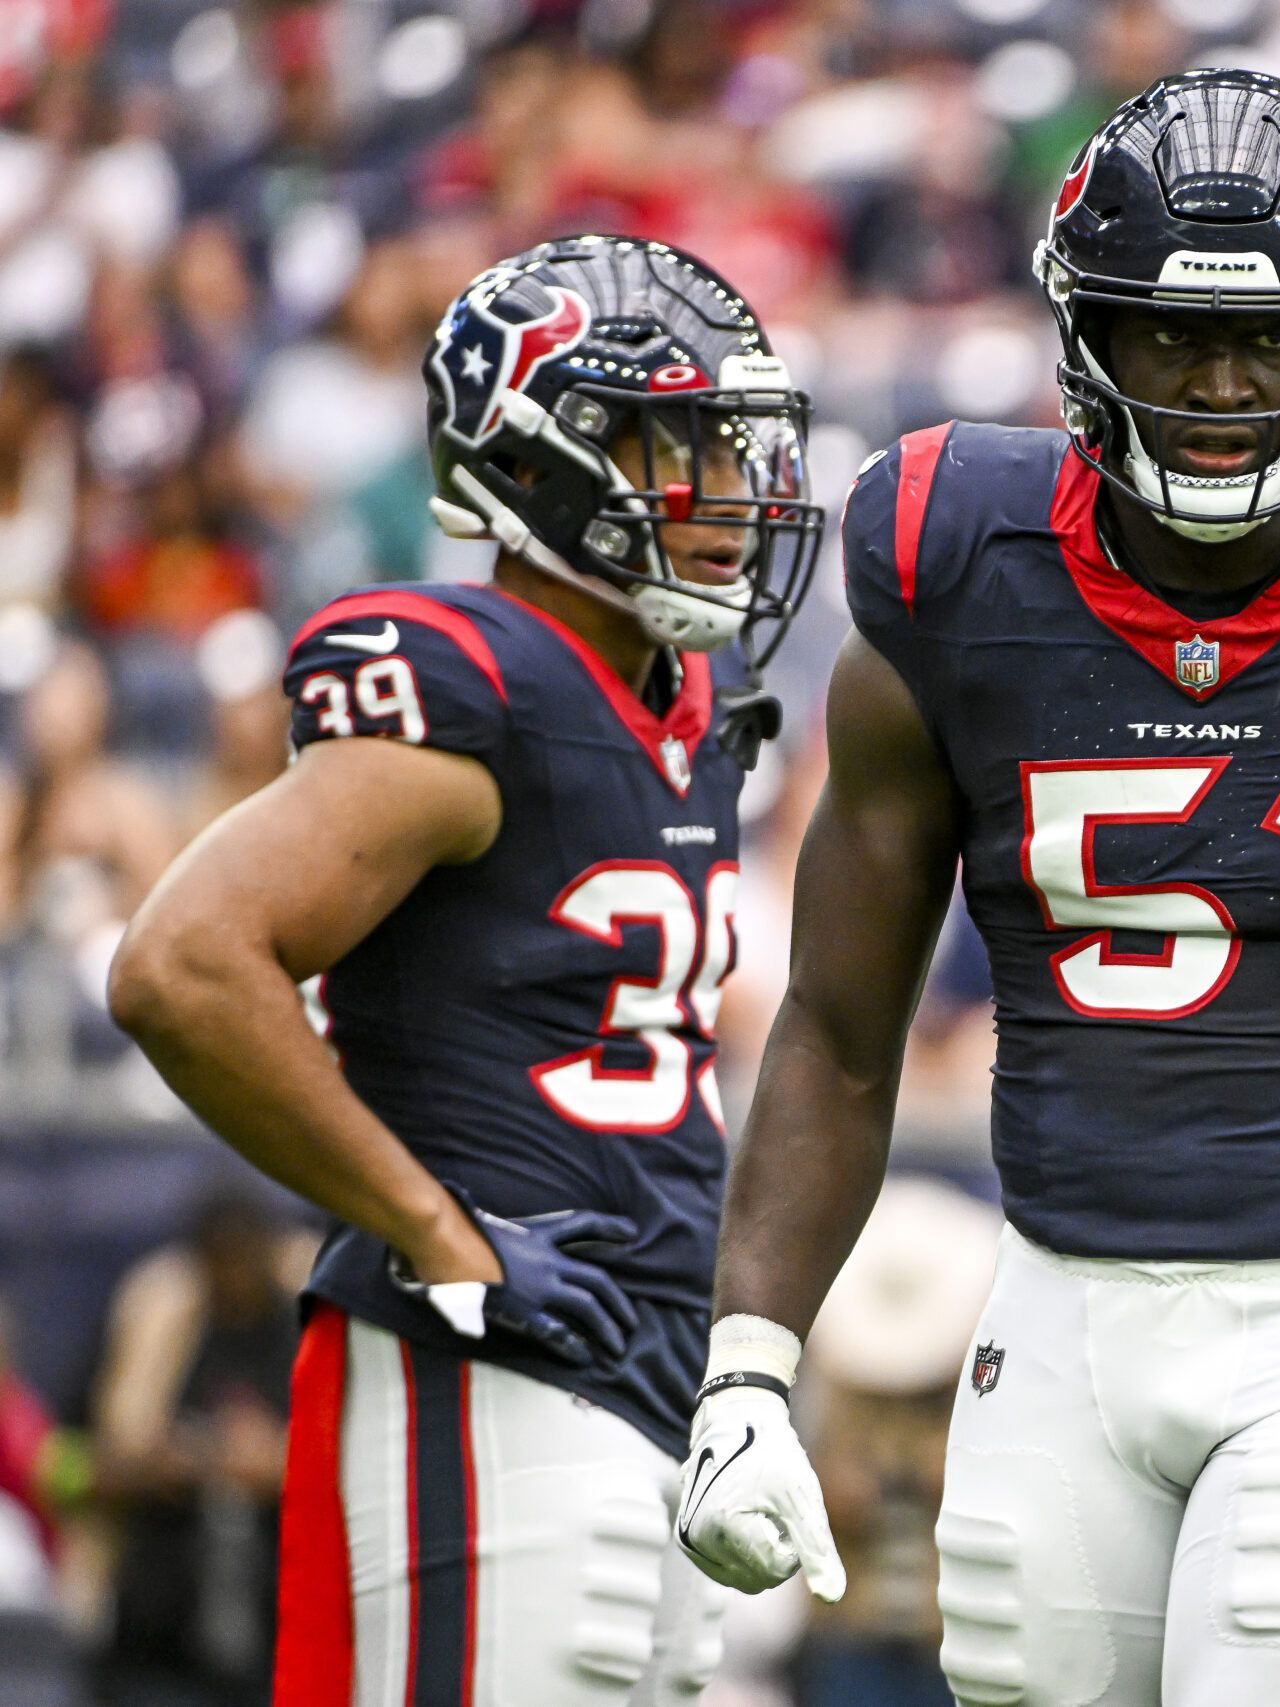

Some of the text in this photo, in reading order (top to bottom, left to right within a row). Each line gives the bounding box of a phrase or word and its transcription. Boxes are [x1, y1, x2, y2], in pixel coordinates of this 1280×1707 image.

[1180, 260, 1258, 272] TEXANS
[1183, 662, 1213, 682] NFL
[301, 655, 429, 745] 39
[1127, 722, 1263, 740] TEXANS
